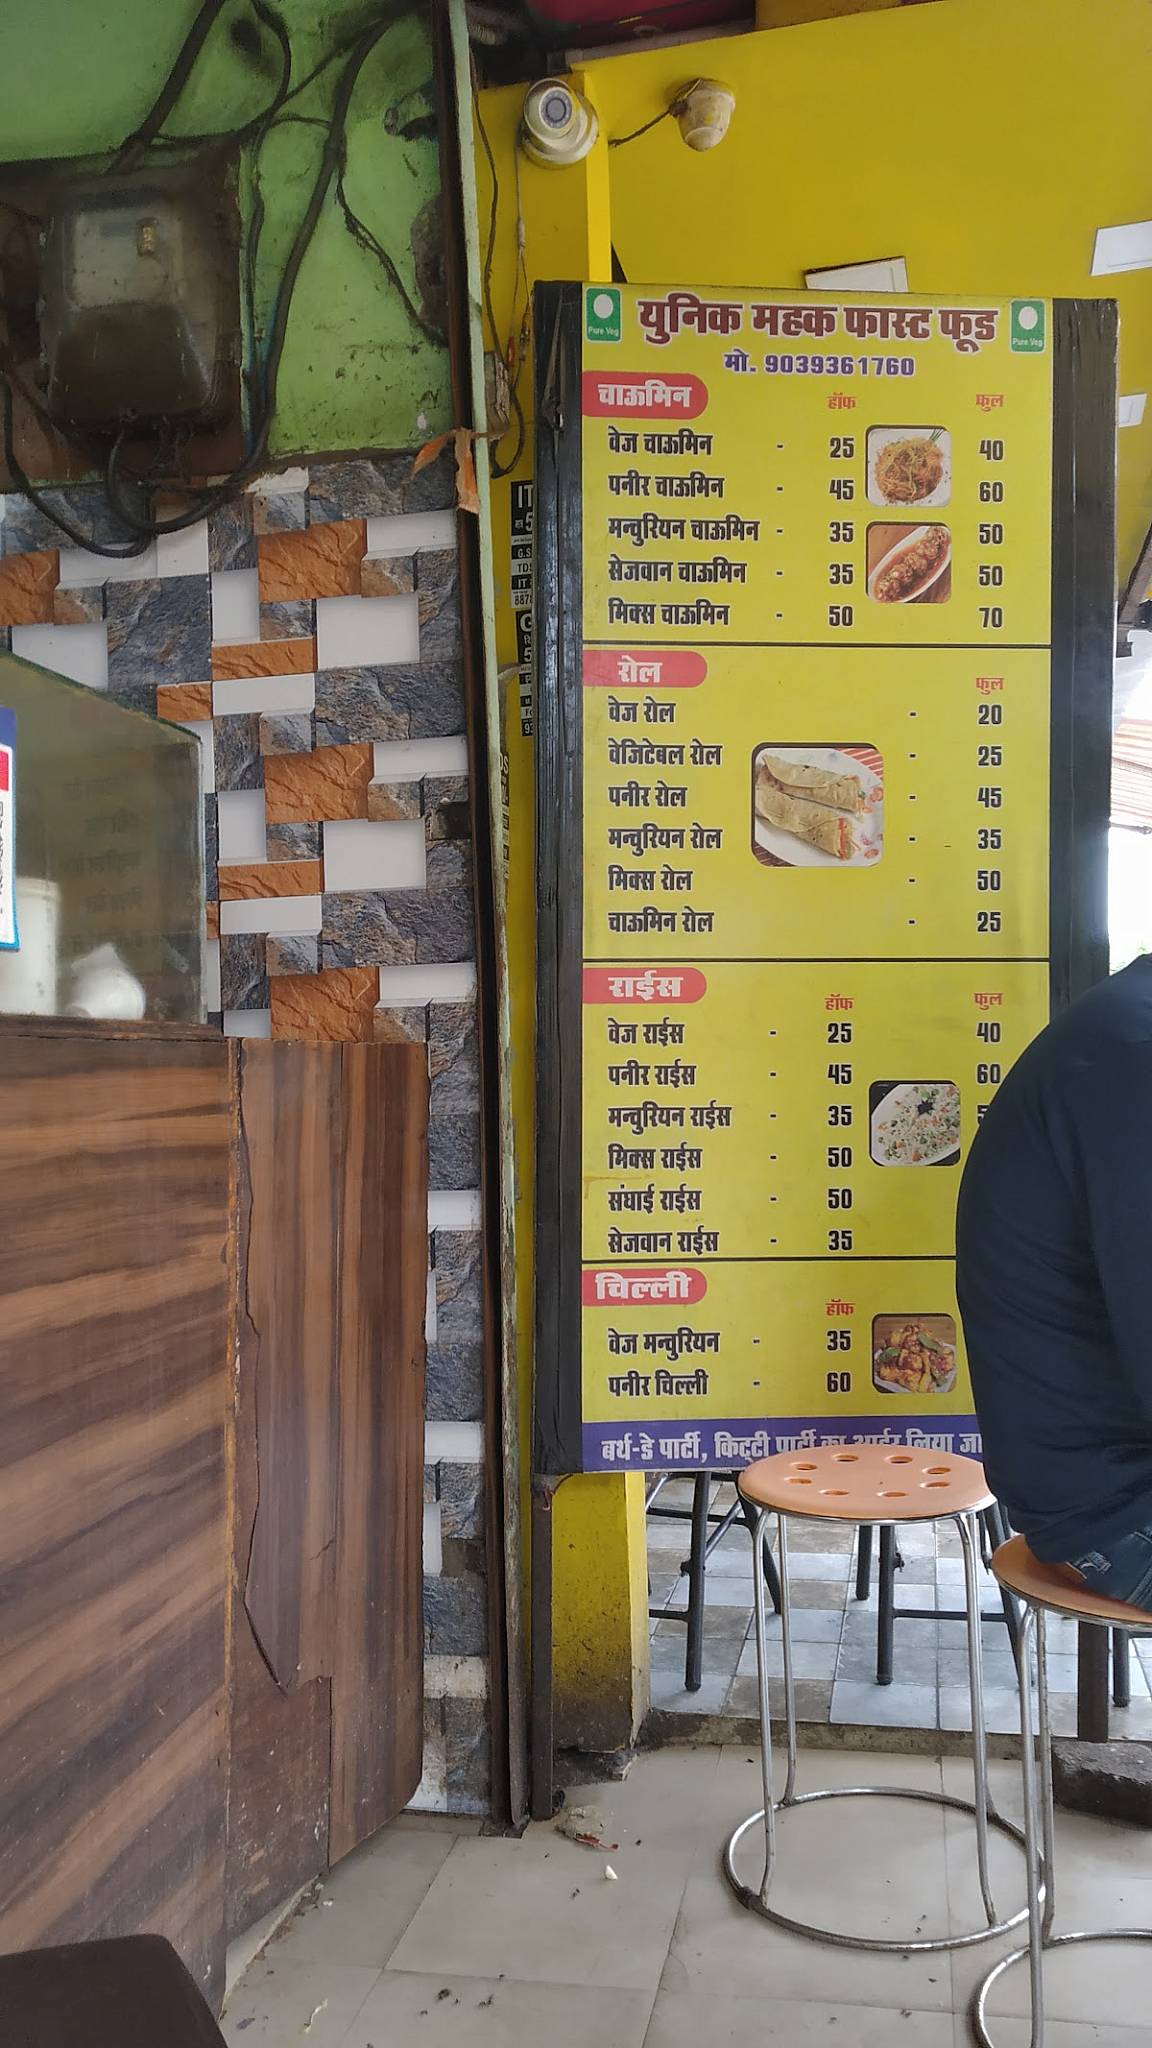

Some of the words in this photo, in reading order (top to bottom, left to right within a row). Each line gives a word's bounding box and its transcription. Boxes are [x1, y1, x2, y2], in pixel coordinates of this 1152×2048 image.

[588, 326, 604, 336] Pure
[605, 327, 619, 338] Veg
[637, 292, 743, 345] युनिक
[751, 303, 838, 338] महक
[844, 306, 933, 339] फास्ट
[938, 309, 998, 353] फूड
[1012, 337, 1028, 347] Pure
[1029, 338, 1043, 348] Veg
[724, 348, 757, 373] मो.
[764, 354, 915, 377] 9039361760
[597, 379, 693, 408] चाऊमिन
[827, 391, 857, 410] हॉफ
[976, 393, 1005, 412] फुल
[608, 426, 639, 453] वेज
[643, 428, 713, 455] चाऊमिन
[830, 438, 853, 458] 25
[980, 441, 1003, 460] 40
[608, 470, 651, 496] पनीर
[655, 472, 724, 498] चाऊमिन
[830, 480, 853, 499] 45
[980, 482, 1002, 502] 60
[608, 513, 686, 546] मन्चुरियन
[691, 515, 760, 540] चाऊमिन
[830, 522, 853, 542] 35
[980, 524, 1002, 544] 50
[518, 548, 531, 559] G.S
[608, 554, 673, 581] सेजवान
[678, 557, 747, 583] चाऊमिन
[830, 564, 853, 584] 35
[980, 566, 1002, 585] 50
[608, 598, 656, 624] मिक्स
[661, 599, 730, 625] चाऊमिन
[830, 606, 852, 626] 50
[980, 608, 1002, 627] 70
[617, 655, 663, 683] रोल
[976, 676, 1004, 695] फुल
[608, 696, 638, 722] वेज
[643, 696, 676, 722] रोल
[979, 705, 1001, 724] 20
[608, 738, 685, 764] वेजिटेबल
[690, 739, 722, 765] रोल
[979, 746, 1001, 765] 25
[609, 781, 651, 806] पनीर
[655, 781, 687, 806] रोल
[978, 788, 1001, 807] 45
[608, 823, 685, 856] मन्चुरियन
[690, 823, 722, 848] रोल
[978, 829, 1001, 849] 35
[609, 865, 656, 890] मिक्स
[661, 865, 693, 890] रोल
[978, 871, 1000, 890] 50
[608, 907, 677, 932] चाऊमिन
[682, 906, 714, 932] रोल
[978, 912, 1000, 931] 25
[608, 970, 684, 1001] राईस
[825, 993, 854, 1011] हॉफ
[974, 992, 1003, 1010] फुल
[608, 1018, 638, 1044] वेज
[643, 1017, 684, 1046] राईस
[828, 1023, 851, 1043] 25
[977, 1023, 1000, 1042] 40
[608, 1060, 650, 1085] पनीर
[654, 1059, 696, 1088] राईस
[828, 1064, 851, 1084] 45
[977, 1064, 1000, 1084] 60
[608, 1101, 685, 1135] मन्चुरियन
[690, 1100, 732, 1129] राईस
[828, 1106, 851, 1125] 35
[608, 1144, 656, 1169] मिक्स
[660, 1142, 702, 1171] राईस
[828, 1147, 851, 1167] 50
[608, 1184, 654, 1213] संघाई
[660, 1184, 702, 1213] राईस
[828, 1189, 852, 1209] 50
[608, 1227, 672, 1253] सेजवान
[677, 1225, 719, 1255] राईस
[829, 1231, 852, 1250] 35
[595, 1271, 692, 1300] चिल्ली
[825, 1299, 856, 1316] हॉफ
[608, 1328, 638, 1354] वेज
[643, 1327, 720, 1361] मन्चुरियन
[827, 1331, 851, 1350] 35
[608, 1371, 651, 1396] पनीर
[655, 1369, 708, 1395] चिल्ली
[827, 1372, 850, 1392] 60
[601, 1432, 655, 1462] बर्थ-डे
[659, 1431, 708, 1463] पार्टी,
